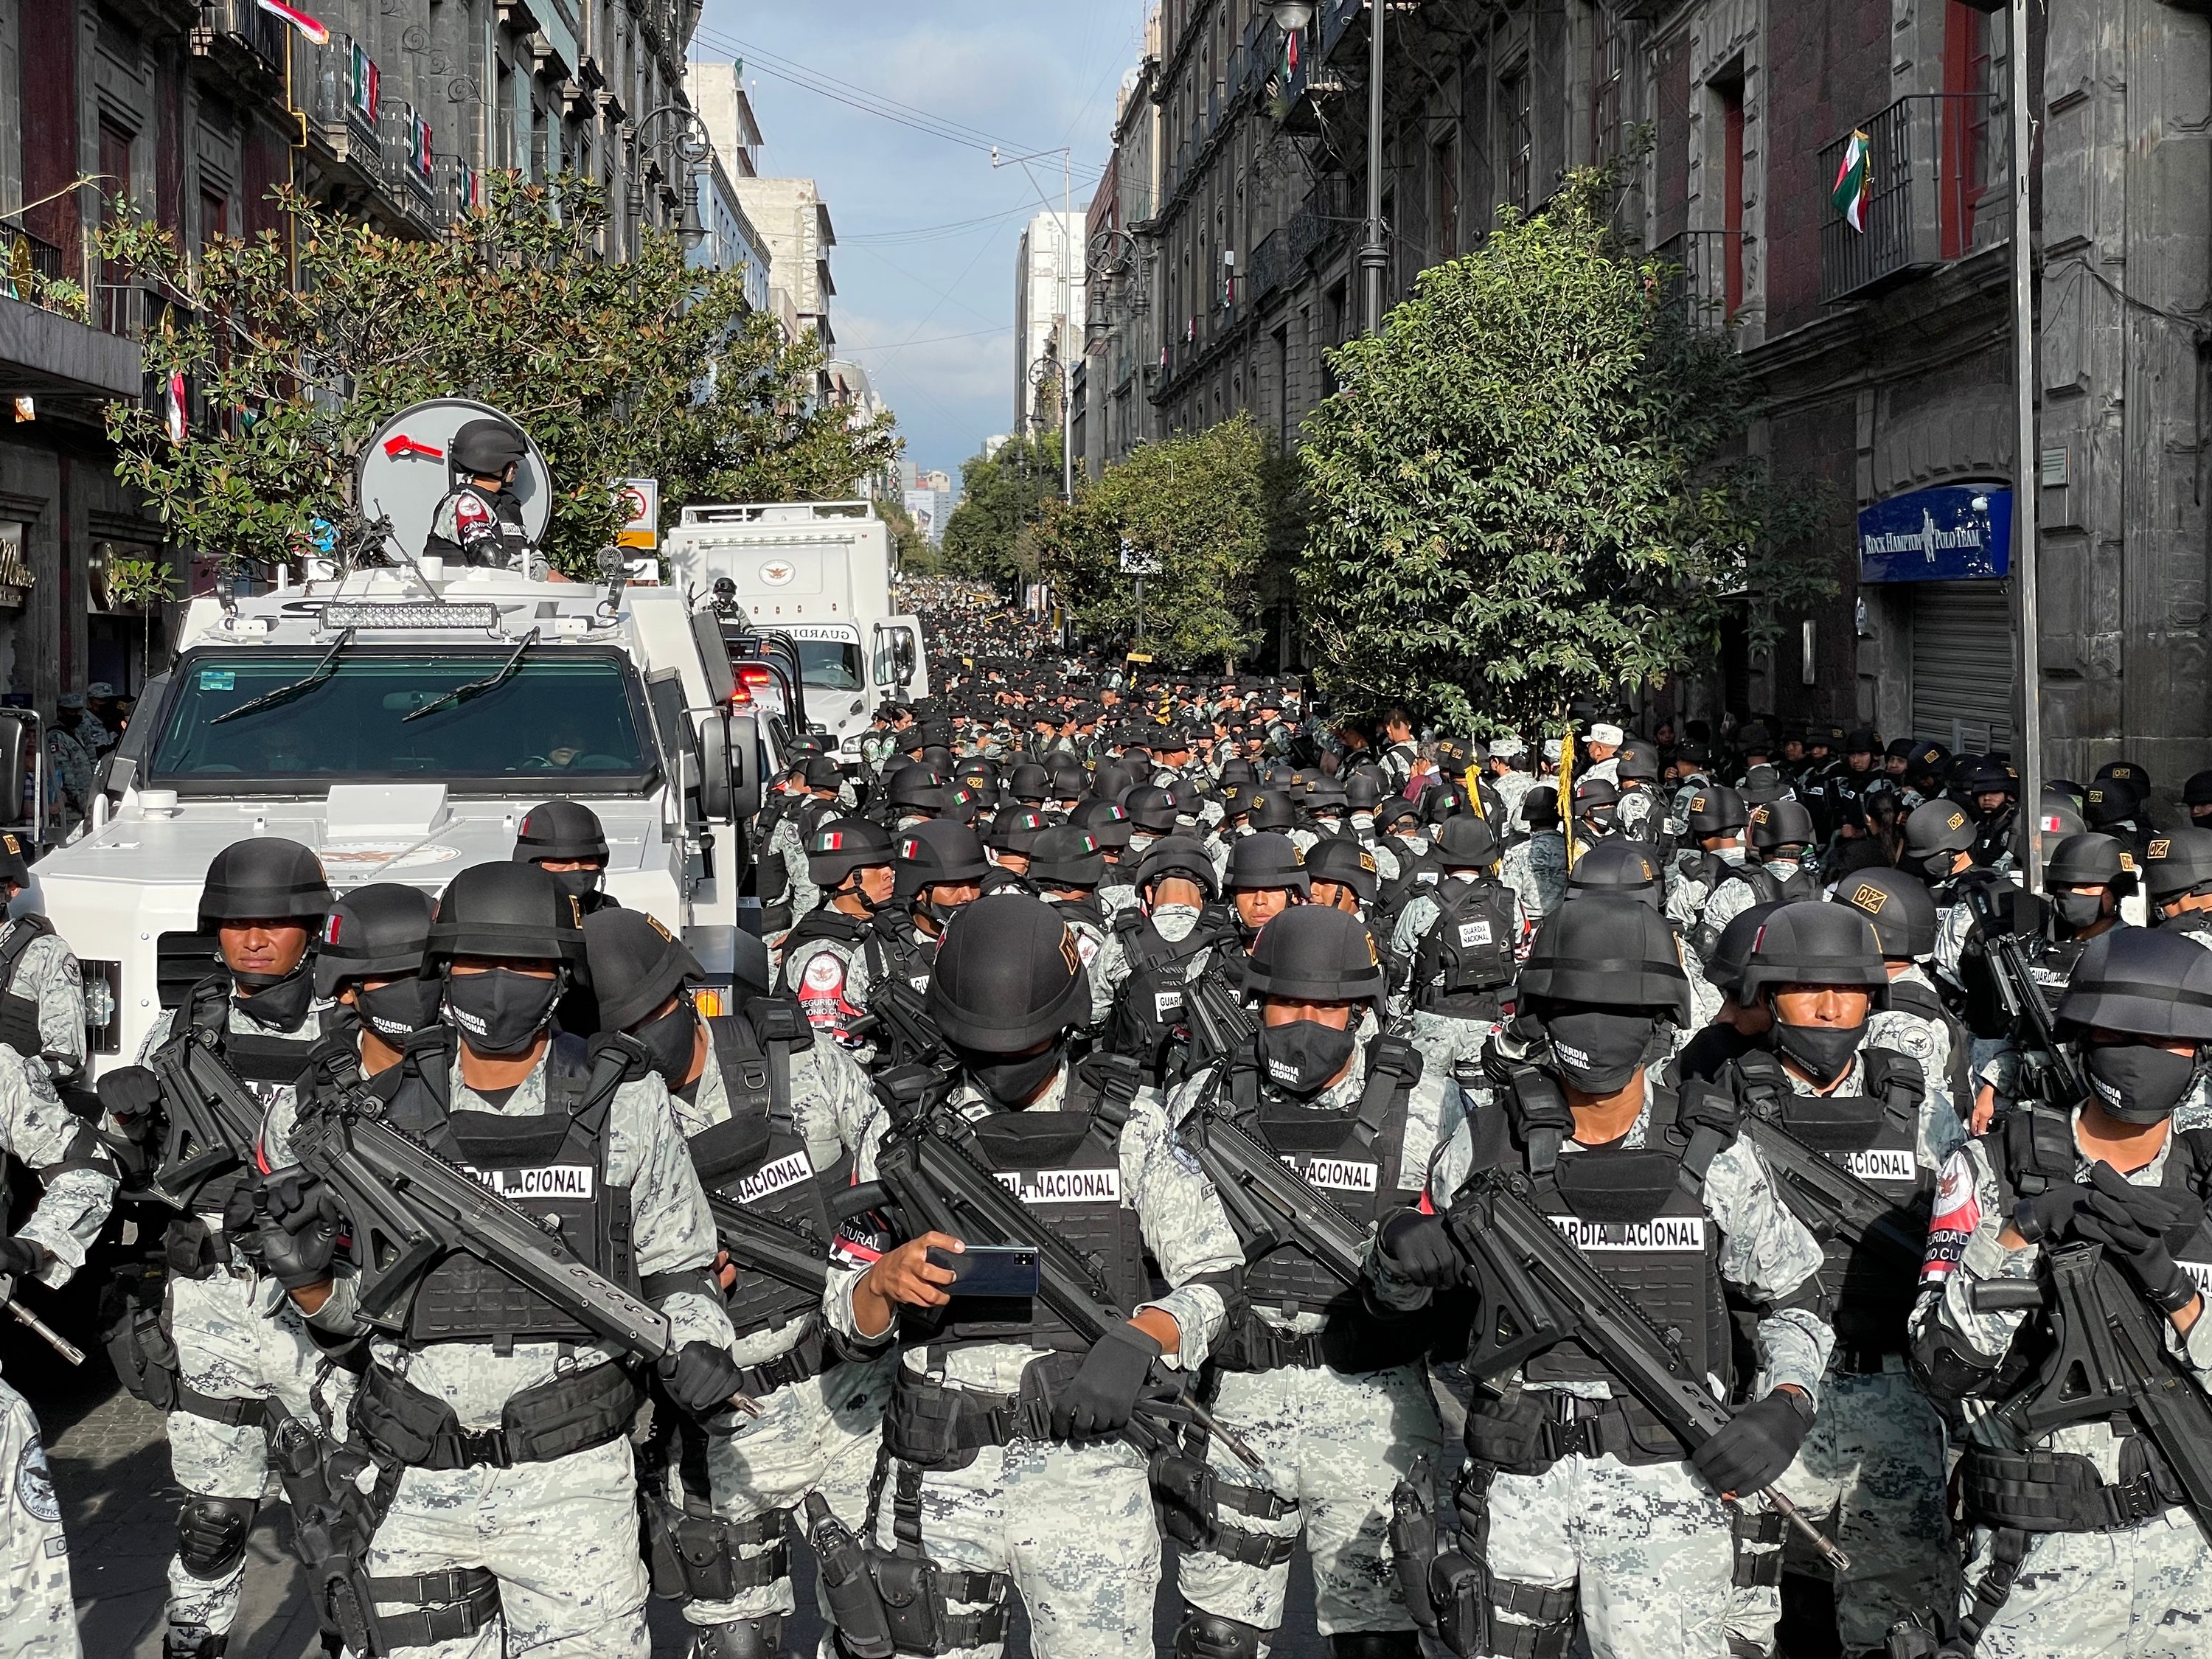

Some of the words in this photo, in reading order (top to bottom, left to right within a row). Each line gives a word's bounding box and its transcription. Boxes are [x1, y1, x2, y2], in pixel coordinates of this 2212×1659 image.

[1865, 535, 1886, 554] ROCK
[1885, 532, 1922, 553] HAMPTON
[1934, 529, 1955, 549] POLO
[1955, 526, 1980, 548] TEAM
[1463, 925, 1486, 936] GUARDIA
[1463, 934, 1489, 944] NACIONAL
[1160, 995, 1183, 1007] GUARD
[372, 1016, 413, 1033] GUARDIA
[1268, 1058, 1299, 1077] UARDIA
[1270, 1068, 1298, 1084] CIONAL
[1843, 1152, 1910, 1175] ACIONAL
[1618, 1222, 1700, 1246] ACIONAL
[32, 1504, 58, 1517] JUSTIC
